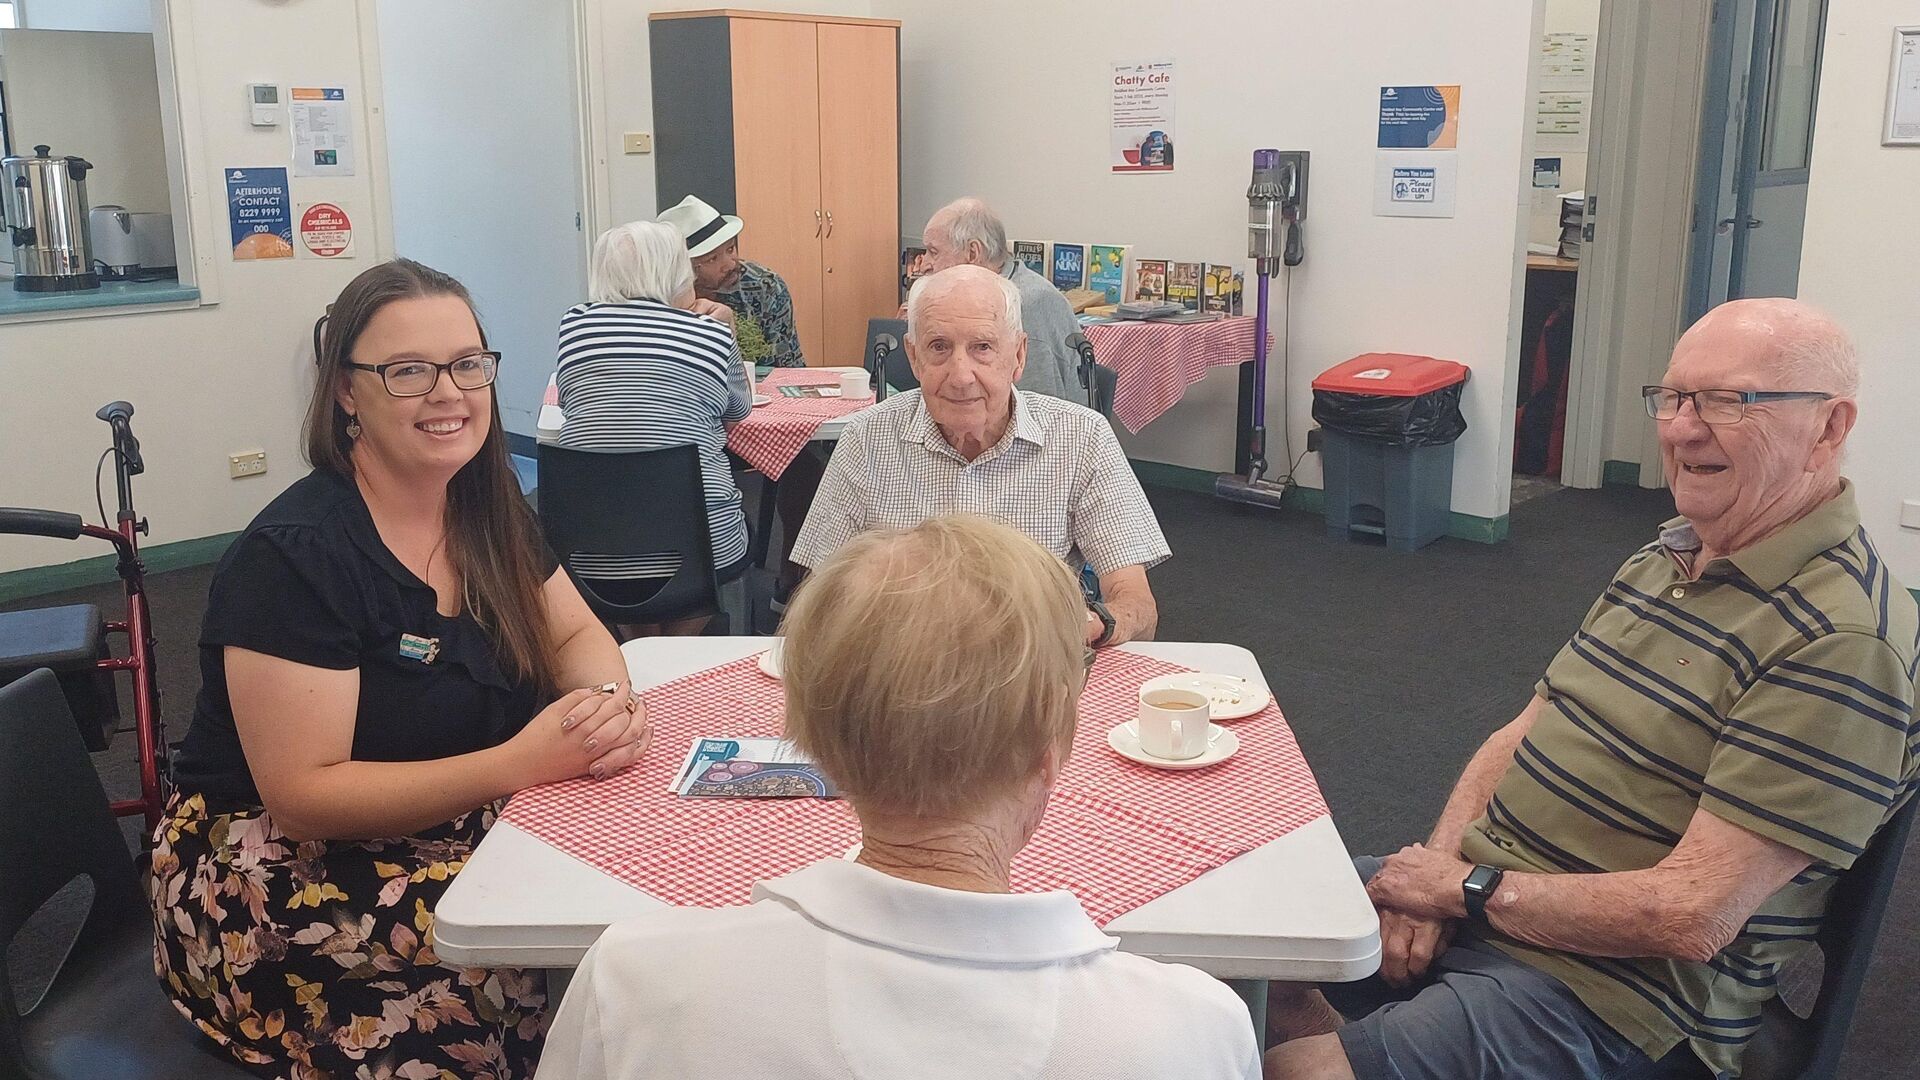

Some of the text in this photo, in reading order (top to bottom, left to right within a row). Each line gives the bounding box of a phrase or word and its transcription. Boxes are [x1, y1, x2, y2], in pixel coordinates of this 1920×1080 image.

[1115, 73, 1170, 86] Chatty Cafe
[1408, 179, 1432, 188] Please
[235, 187, 282, 195] AFTERHOURS
[239, 196, 280, 206] CONTACT
[239, 207, 281, 217] 8229 9999
[318, 212, 332, 220] DRY
[307, 218, 343, 226] CHEMICALS
[253, 224, 269, 233] 000
[1055, 259, 1081, 272] NUNN
